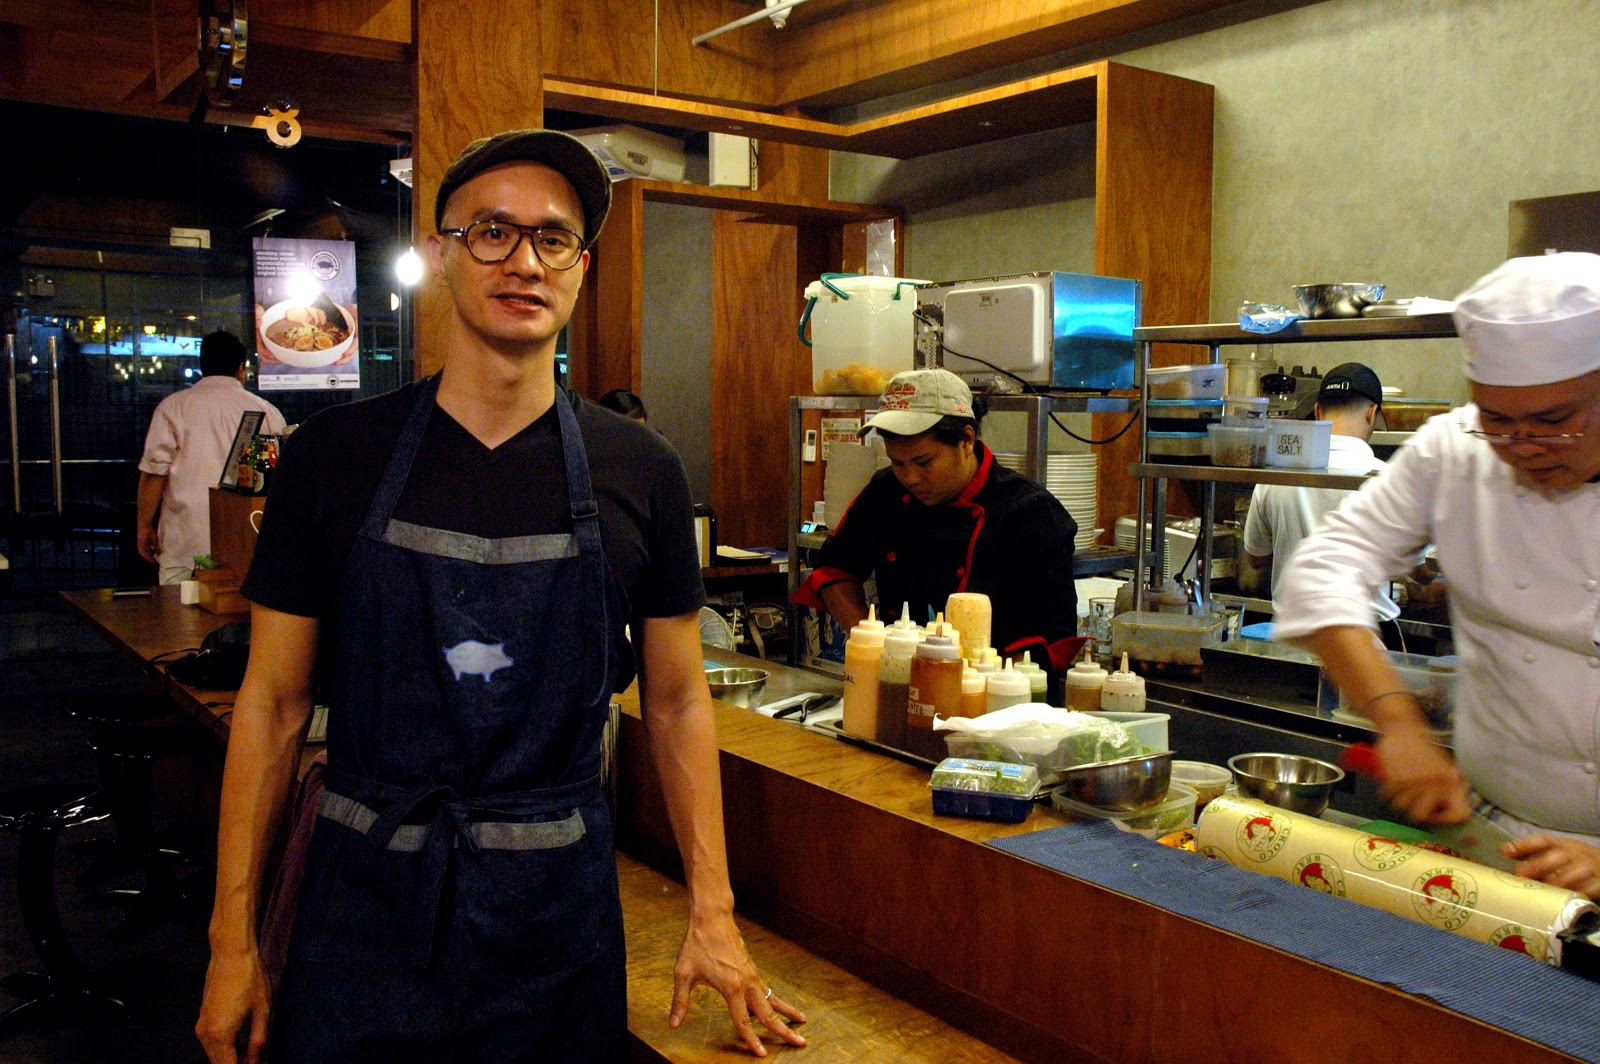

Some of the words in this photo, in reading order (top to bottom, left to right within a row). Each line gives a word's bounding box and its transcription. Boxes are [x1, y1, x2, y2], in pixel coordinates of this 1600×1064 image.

[1280, 435, 1300, 445] SEA
[1278, 445, 1302, 455] SALT
[1444, 890, 1476, 929] CROCO
